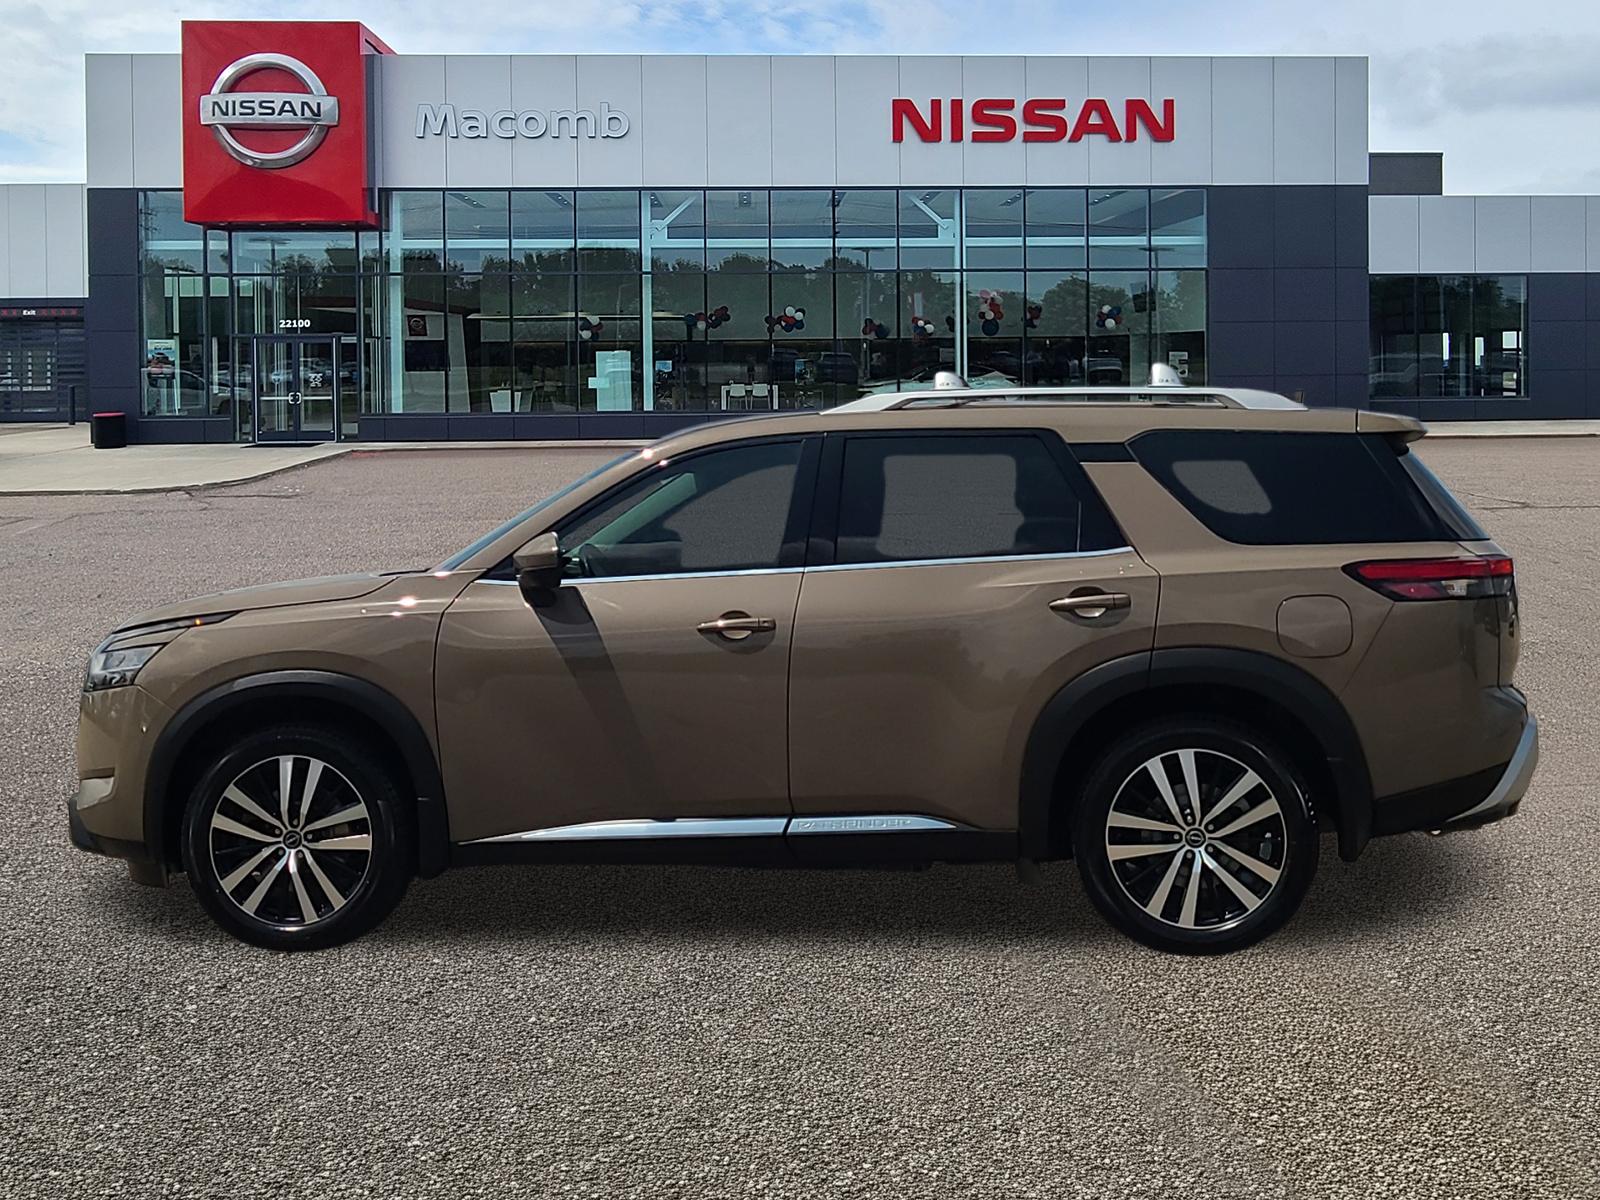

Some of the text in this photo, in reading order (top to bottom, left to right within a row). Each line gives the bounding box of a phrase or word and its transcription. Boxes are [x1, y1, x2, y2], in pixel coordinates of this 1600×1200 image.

[212, 100, 322, 117] NISSAN
[415, 102, 630, 138] Macomb
[892, 98, 1175, 142] NISSAN
[279, 319, 311, 328] 22100
